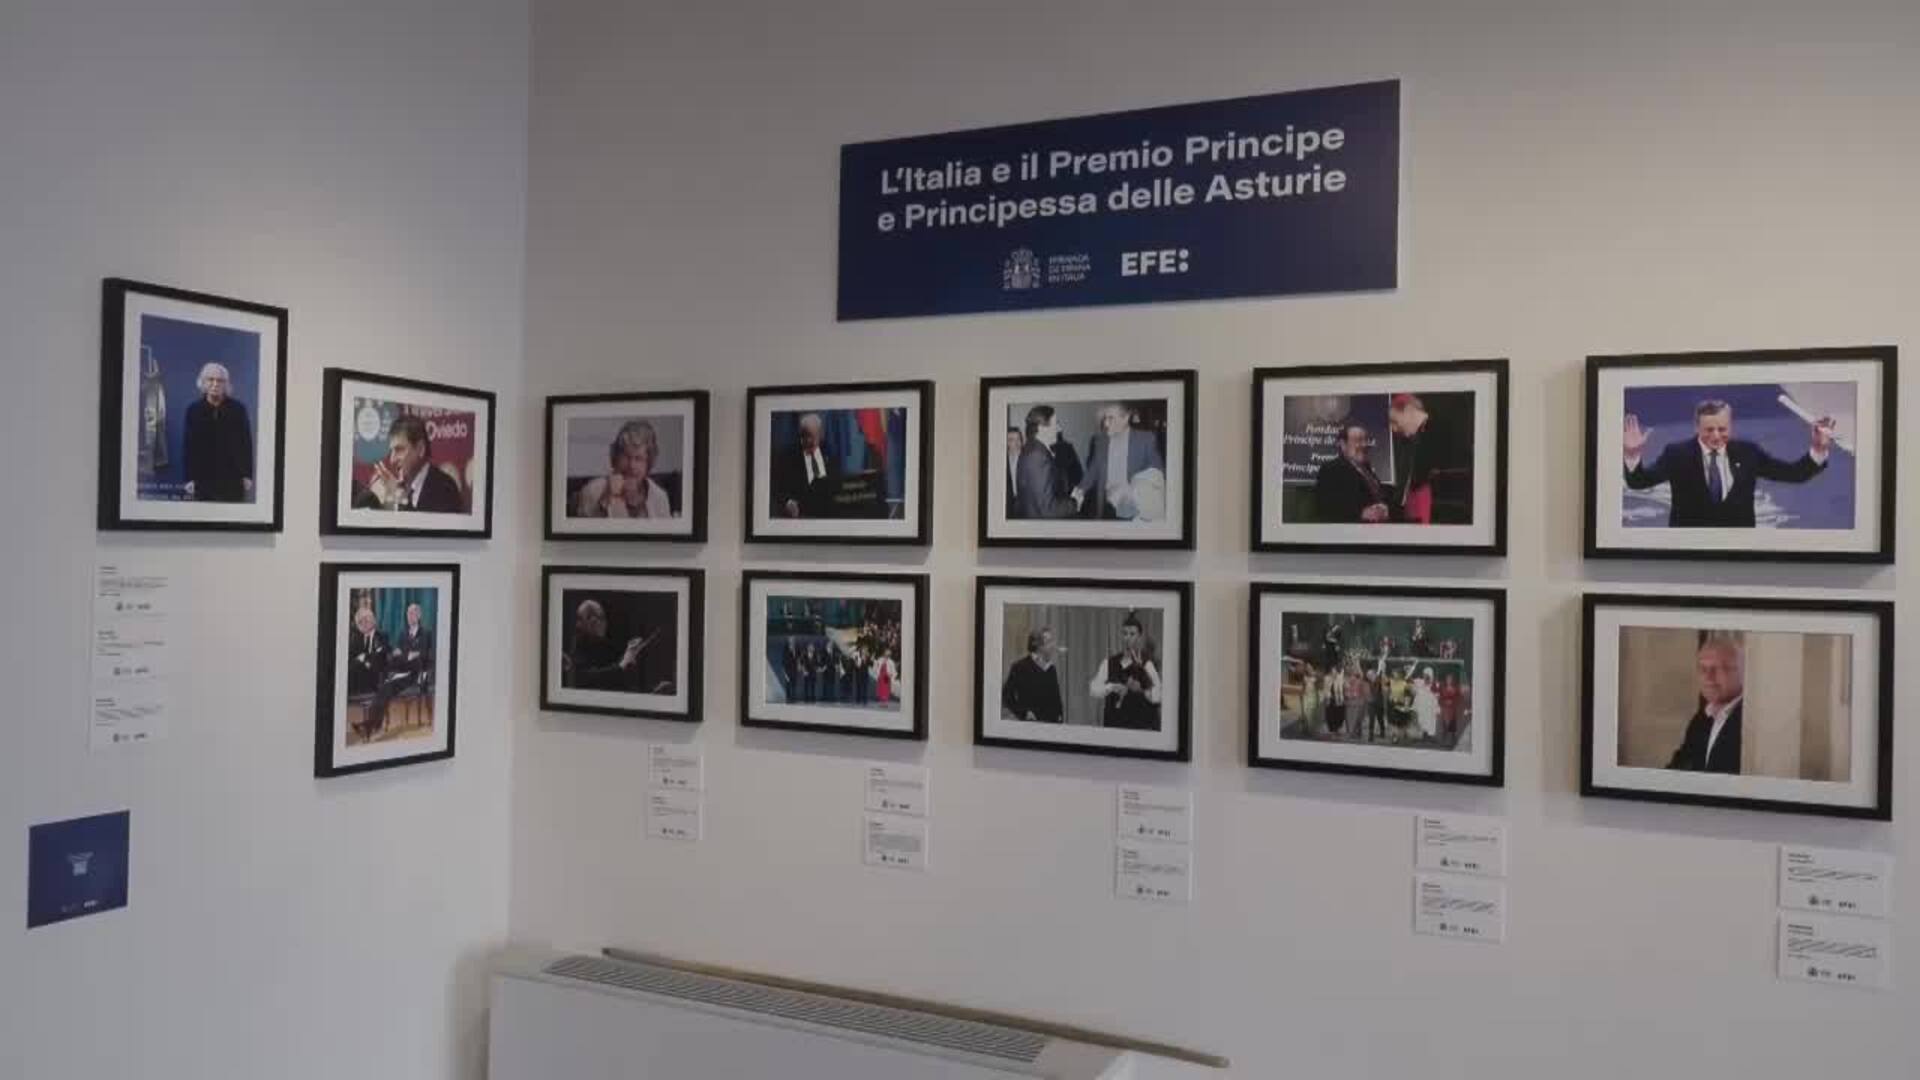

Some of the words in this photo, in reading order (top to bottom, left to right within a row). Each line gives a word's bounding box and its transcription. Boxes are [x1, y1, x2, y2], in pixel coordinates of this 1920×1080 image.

[992, 162, 1011, 183] e
[1020, 151, 1039, 182] il
[1050, 140, 1174, 179] Premio
[1185, 125, 1345, 165] Principe
[877, 211, 896, 232] e
[904, 193, 1098, 229] Principessa
[1108, 178, 1196, 211] delle
[1204, 164, 1347, 203] Asturie
